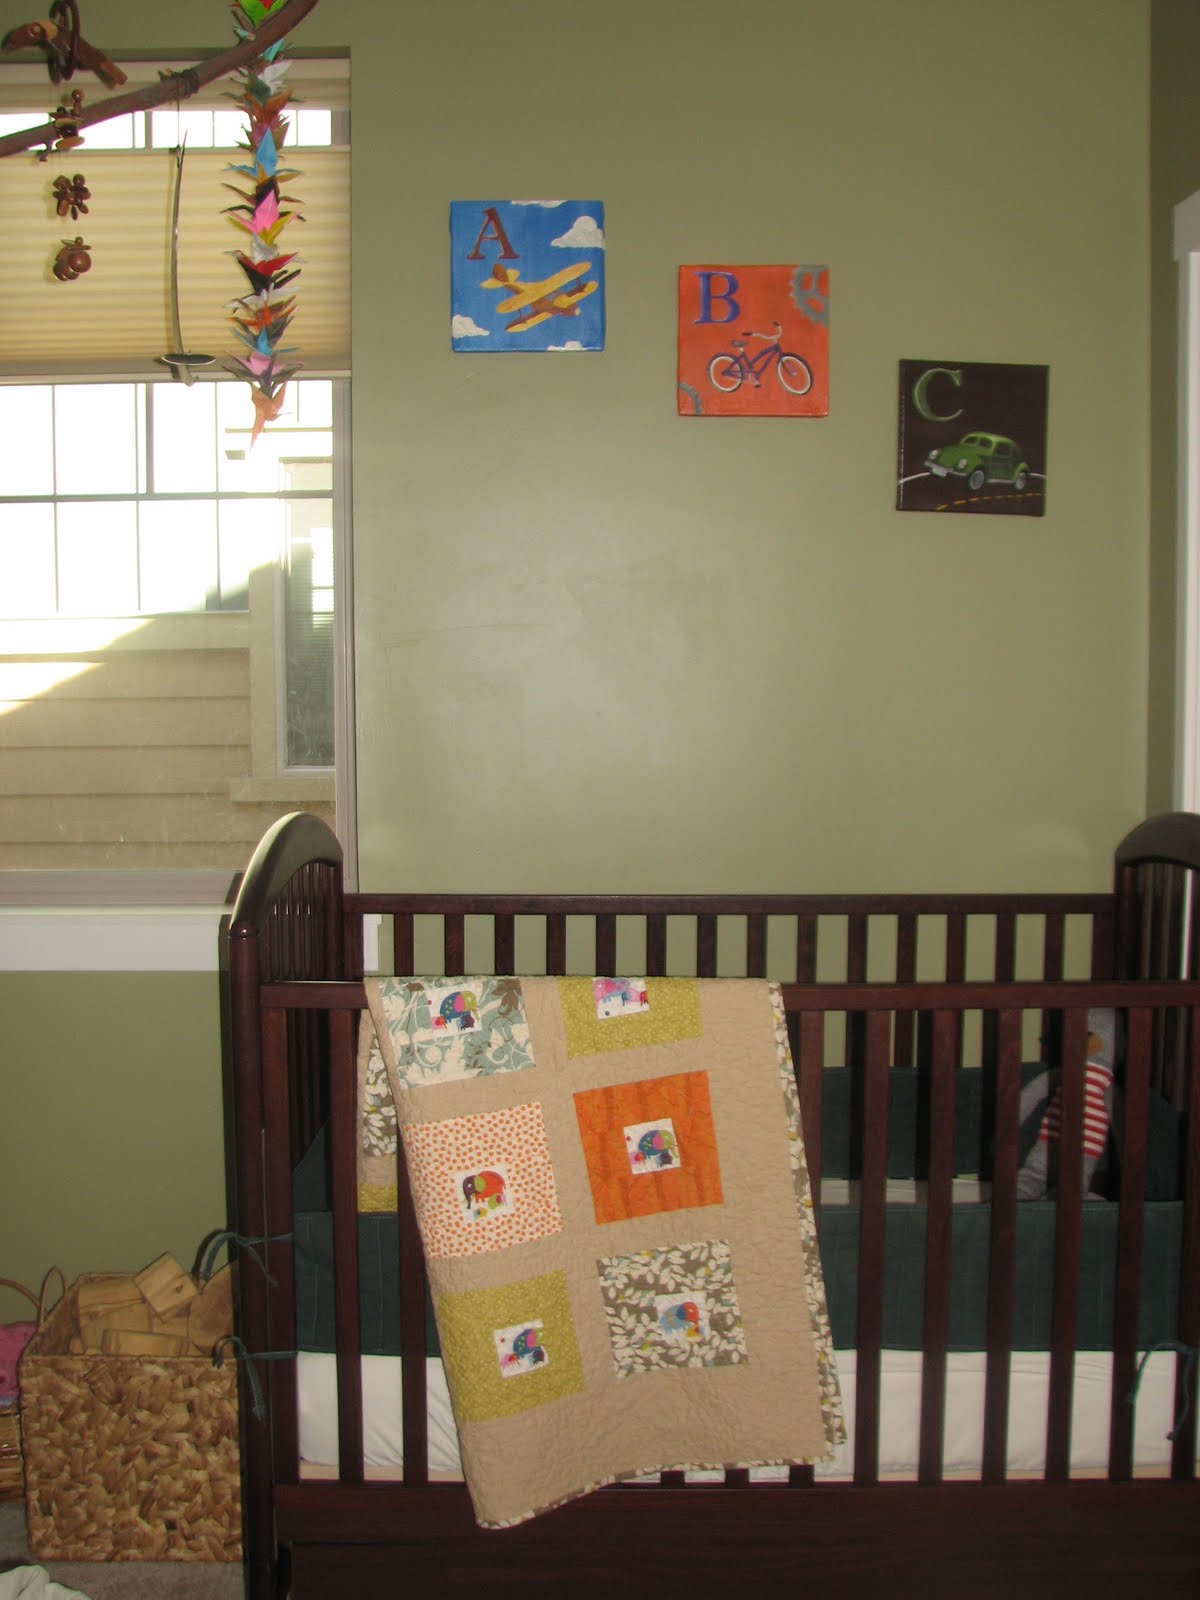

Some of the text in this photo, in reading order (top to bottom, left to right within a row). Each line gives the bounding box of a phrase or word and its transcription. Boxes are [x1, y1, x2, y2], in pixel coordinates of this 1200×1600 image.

[467, 207, 520, 260] A
[693, 271, 741, 325] B
[912, 367, 963, 422] C
